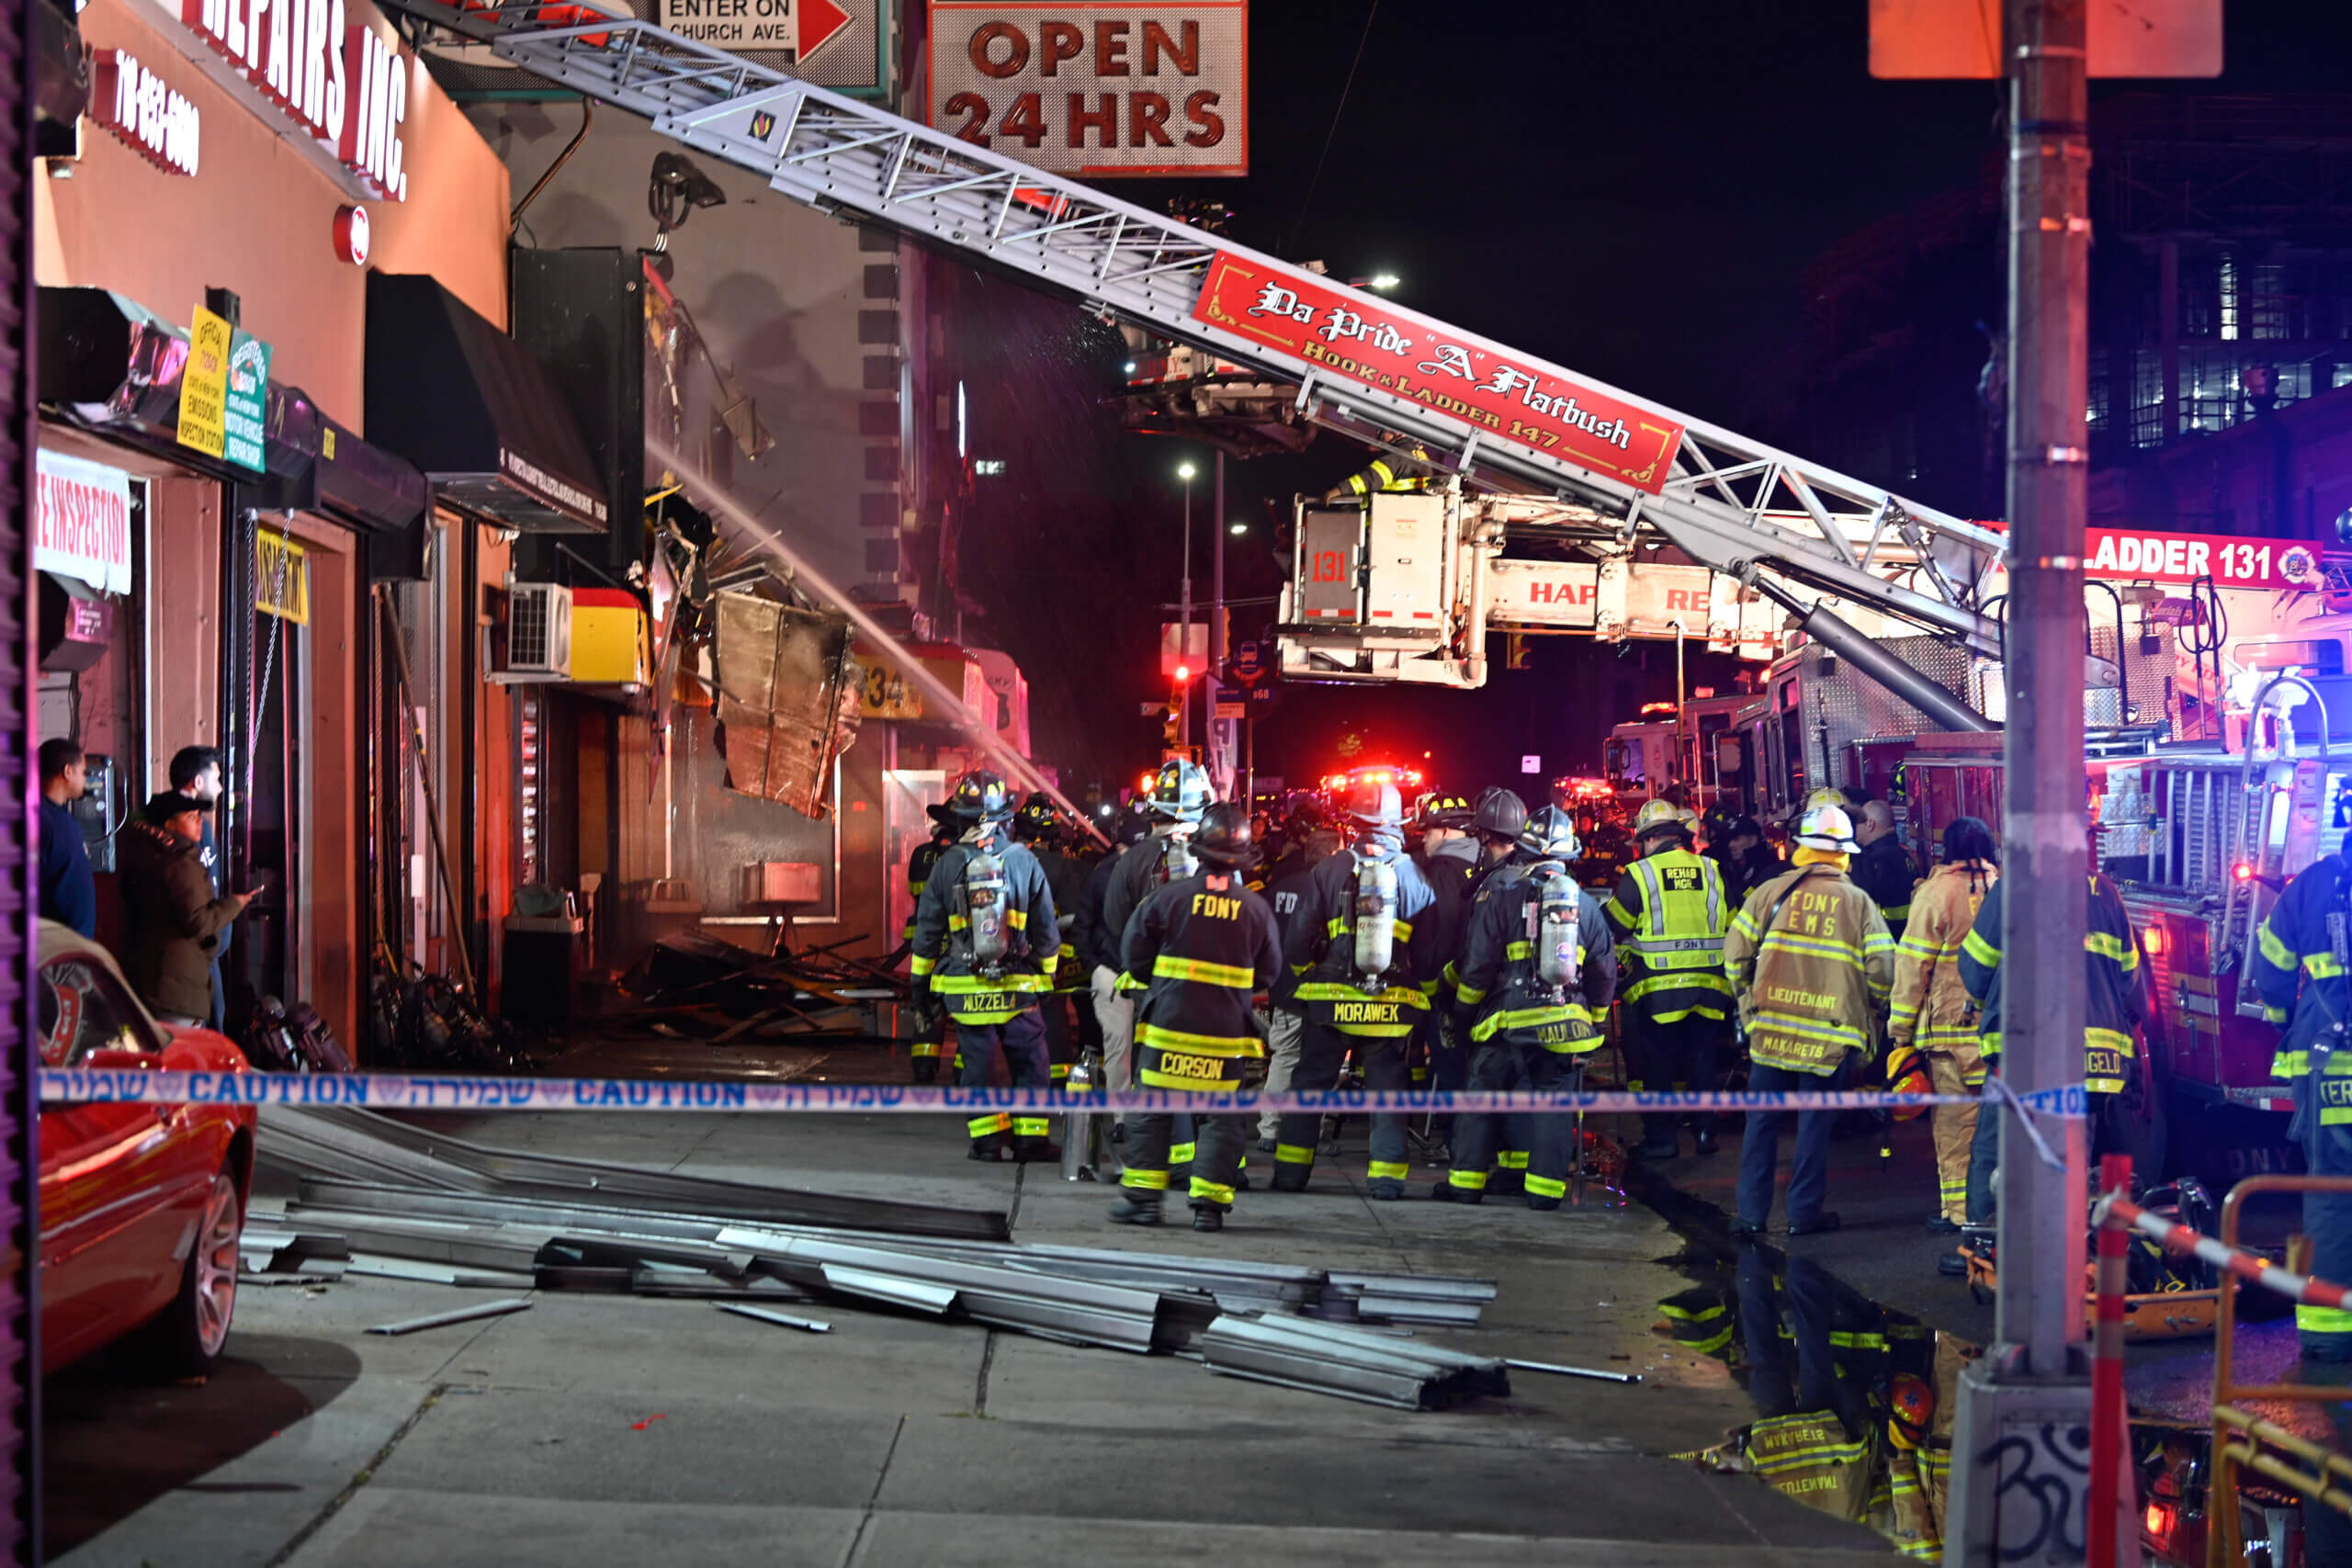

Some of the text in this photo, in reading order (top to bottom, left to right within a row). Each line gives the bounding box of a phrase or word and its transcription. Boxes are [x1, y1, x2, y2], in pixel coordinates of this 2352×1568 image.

[670, 0, 789, 17] ENTER ON
[670, 24, 790, 39] CHURCH AVE.
[969, 20, 1199, 79] OPEN
[199, 0, 406, 202] PAIRS INC.
[944, 90, 1226, 148] 24 HRS
[1248, 281, 1315, 324] Da
[1318, 306, 1412, 356] Pride
[1475, 365, 1631, 450] Flatbush
[1301, 340, 1561, 448] HOOK & LADDER 147
[1312, 551, 1346, 582] 131
[2083, 536, 2271, 580] ADDER 131
[1667, 867, 1698, 879] REHAB
[1193, 893, 1242, 921] FDNY
[1790, 890, 1840, 914] FDNY
[1675, 941, 1705, 950] FDNY
[1334, 1001, 1399, 1022] MORAWEK
[1767, 986, 1837, 1010] LIEUTENANT
[1160, 1052, 1224, 1080] CORSON
[2085, 1054, 2120, 1074] GELO
[40, 1071, 148, 1102] שמיר
[187, 1073, 369, 1105] CAUTION
[409, 1077, 534, 1106] שמירה
[573, 1078, 745, 1107] CAUTION
